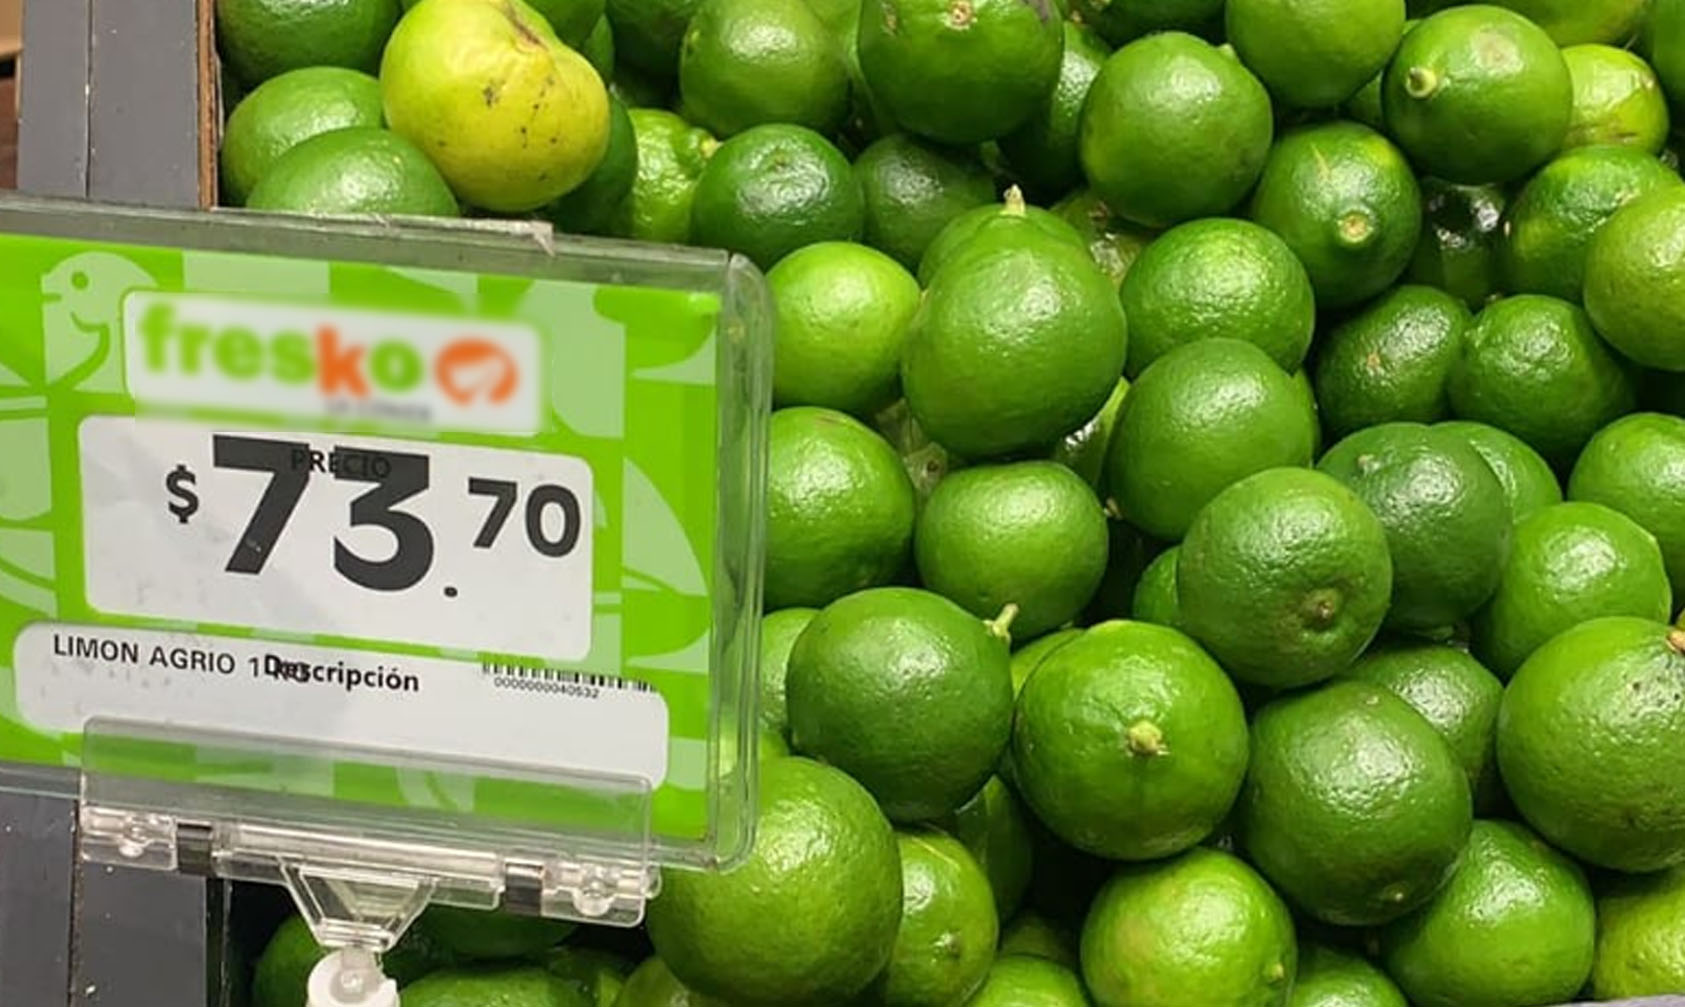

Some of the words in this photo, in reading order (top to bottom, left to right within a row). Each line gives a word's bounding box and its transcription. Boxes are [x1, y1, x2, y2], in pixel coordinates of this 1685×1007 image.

[141, 302, 424, 398] fresko
[165, 464, 199, 524] $
[53, 634, 139, 665] LIMON
[149, 646, 236, 676] AGRIO
[264, 653, 420, 693] Descripción
